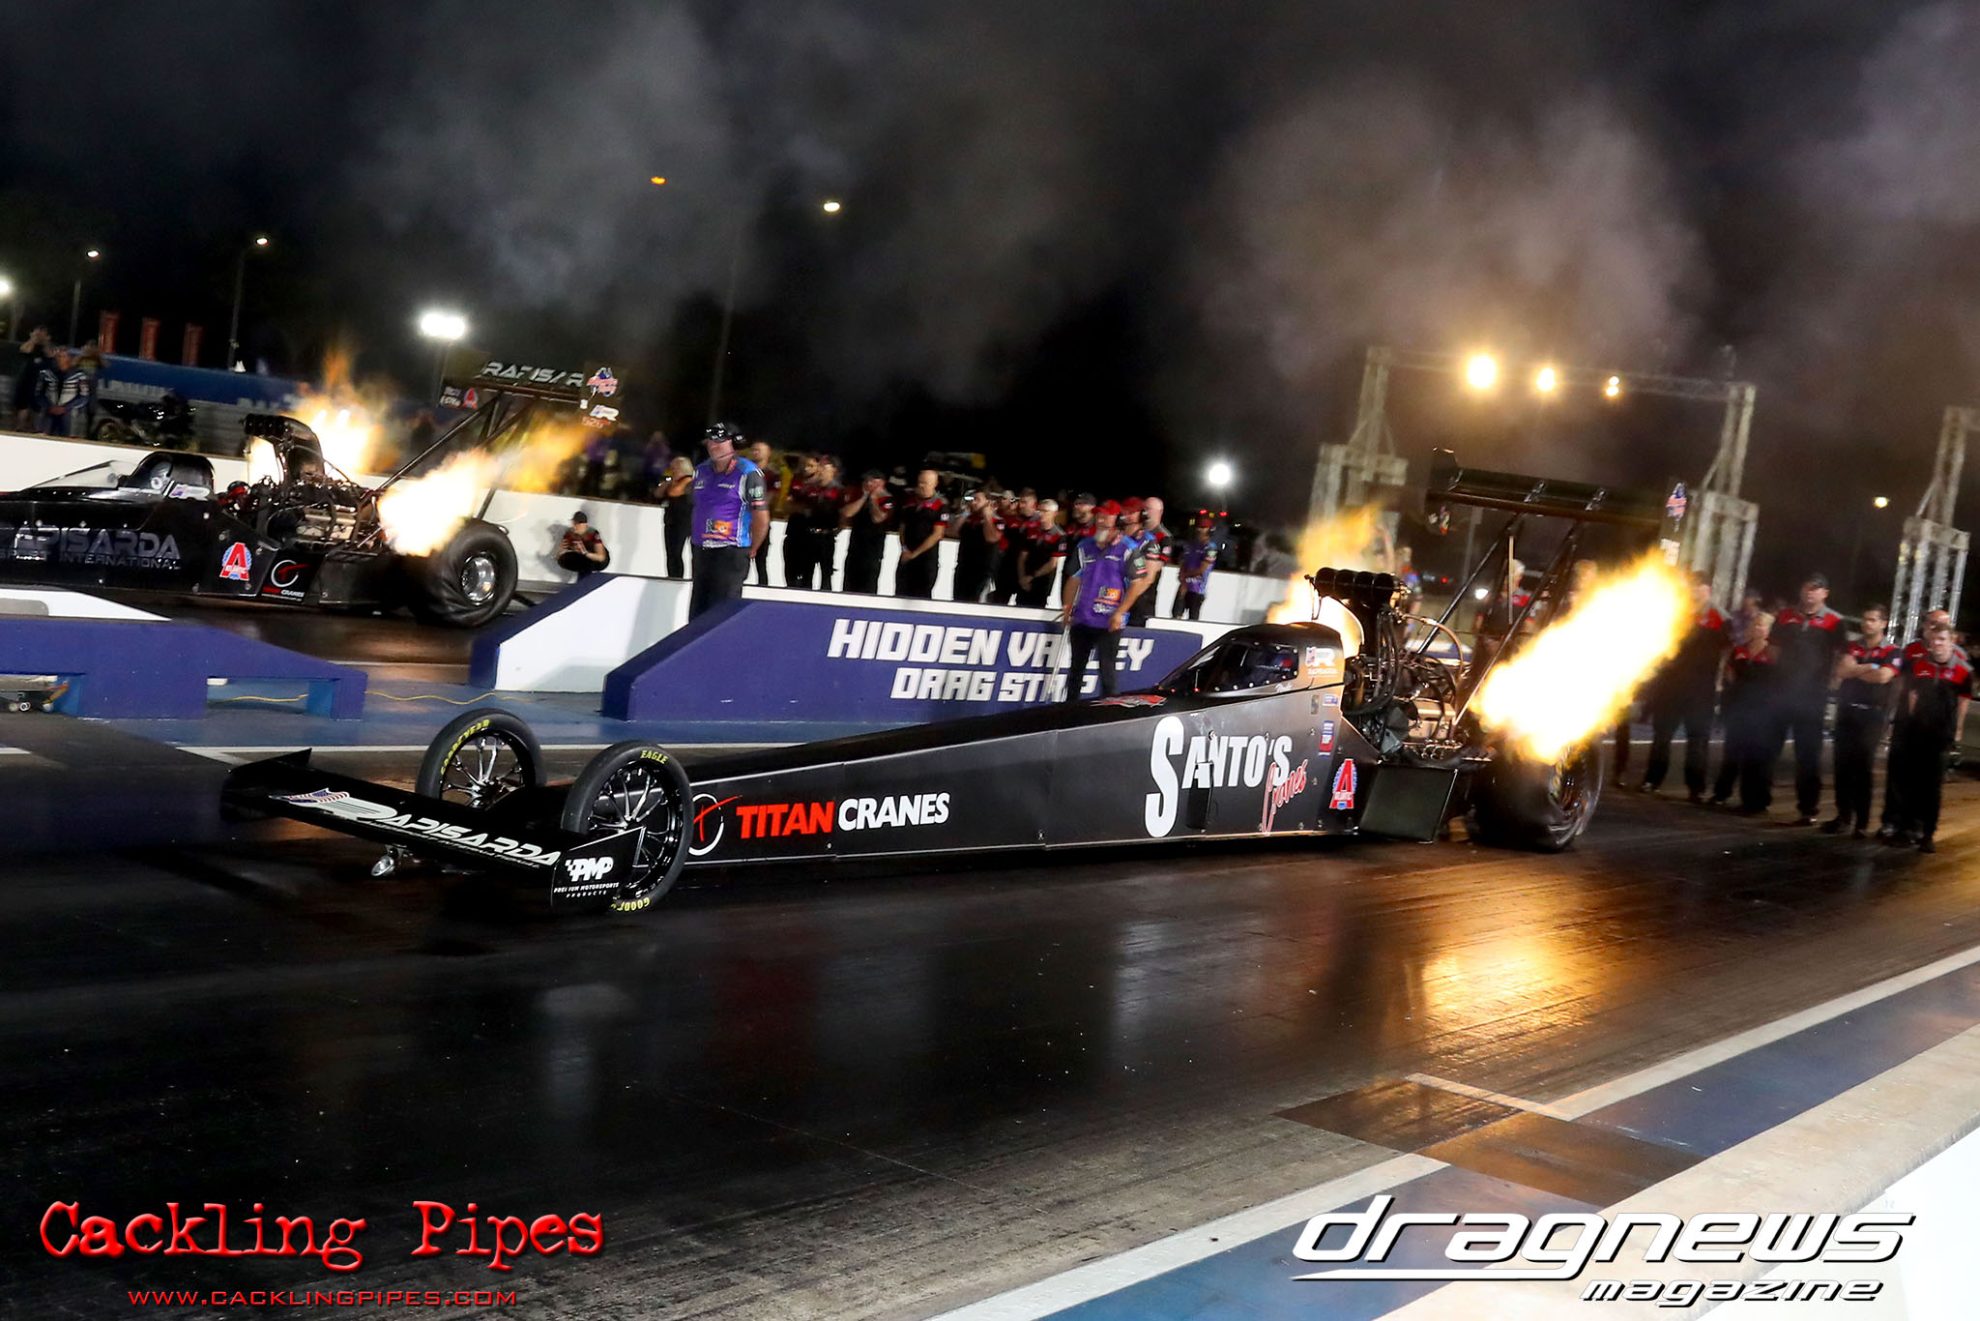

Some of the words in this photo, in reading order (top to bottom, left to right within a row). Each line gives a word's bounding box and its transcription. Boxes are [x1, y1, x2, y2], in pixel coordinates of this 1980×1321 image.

[827, 618, 1003, 666] HIDDEN
[890, 667, 997, 700] DRAG
[640, 750, 669, 764] EAGLE
[1145, 716, 1292, 837] SANTO'S
[736, 801, 834, 839] TITAN
[838, 792, 951, 831] CRANES
[565, 856, 614, 882] PMP
